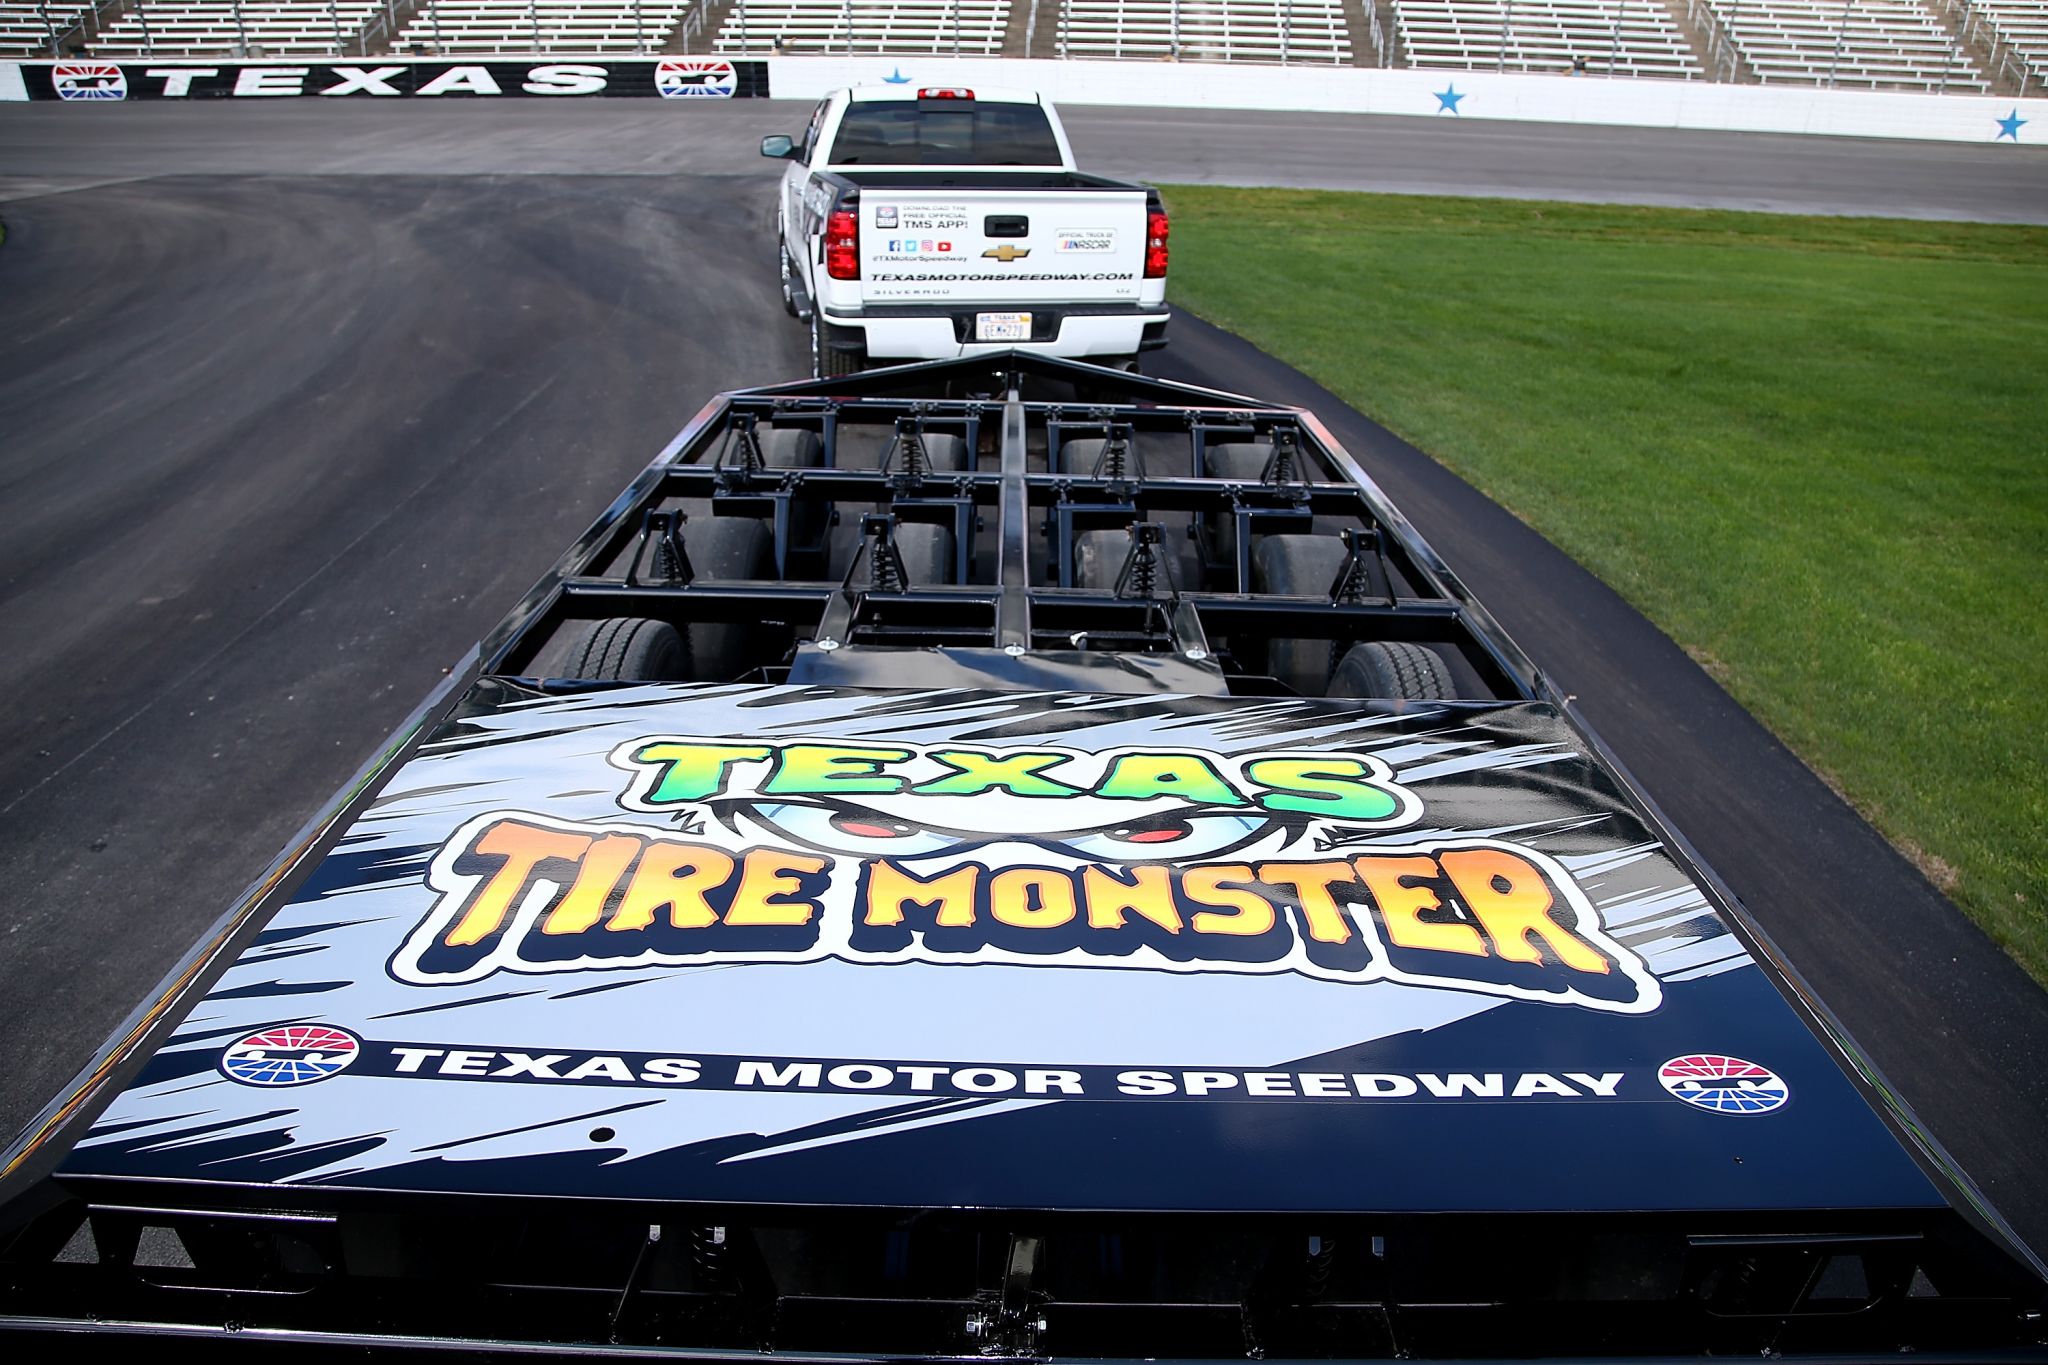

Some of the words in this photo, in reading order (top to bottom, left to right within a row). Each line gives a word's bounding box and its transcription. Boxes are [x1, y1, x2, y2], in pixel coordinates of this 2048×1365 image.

[144, 64, 609, 97] TEXAS
[904, 220, 932, 229] TMS
[937, 220, 968, 229] APP!
[1070, 240, 1111, 249] NASCAR
[871, 272, 1133, 281] TEXASMOTORSPEEDWAY.COM
[630, 741, 1402, 821] TEXAS
[440, 818, 828, 950] TIRE
[861, 846, 1612, 977] MONSTER
[390, 1046, 701, 1085] TEXAS
[733, 1060, 1085, 1095] MOTOR
[1115, 1069, 1625, 1099] SPEEDWAY
